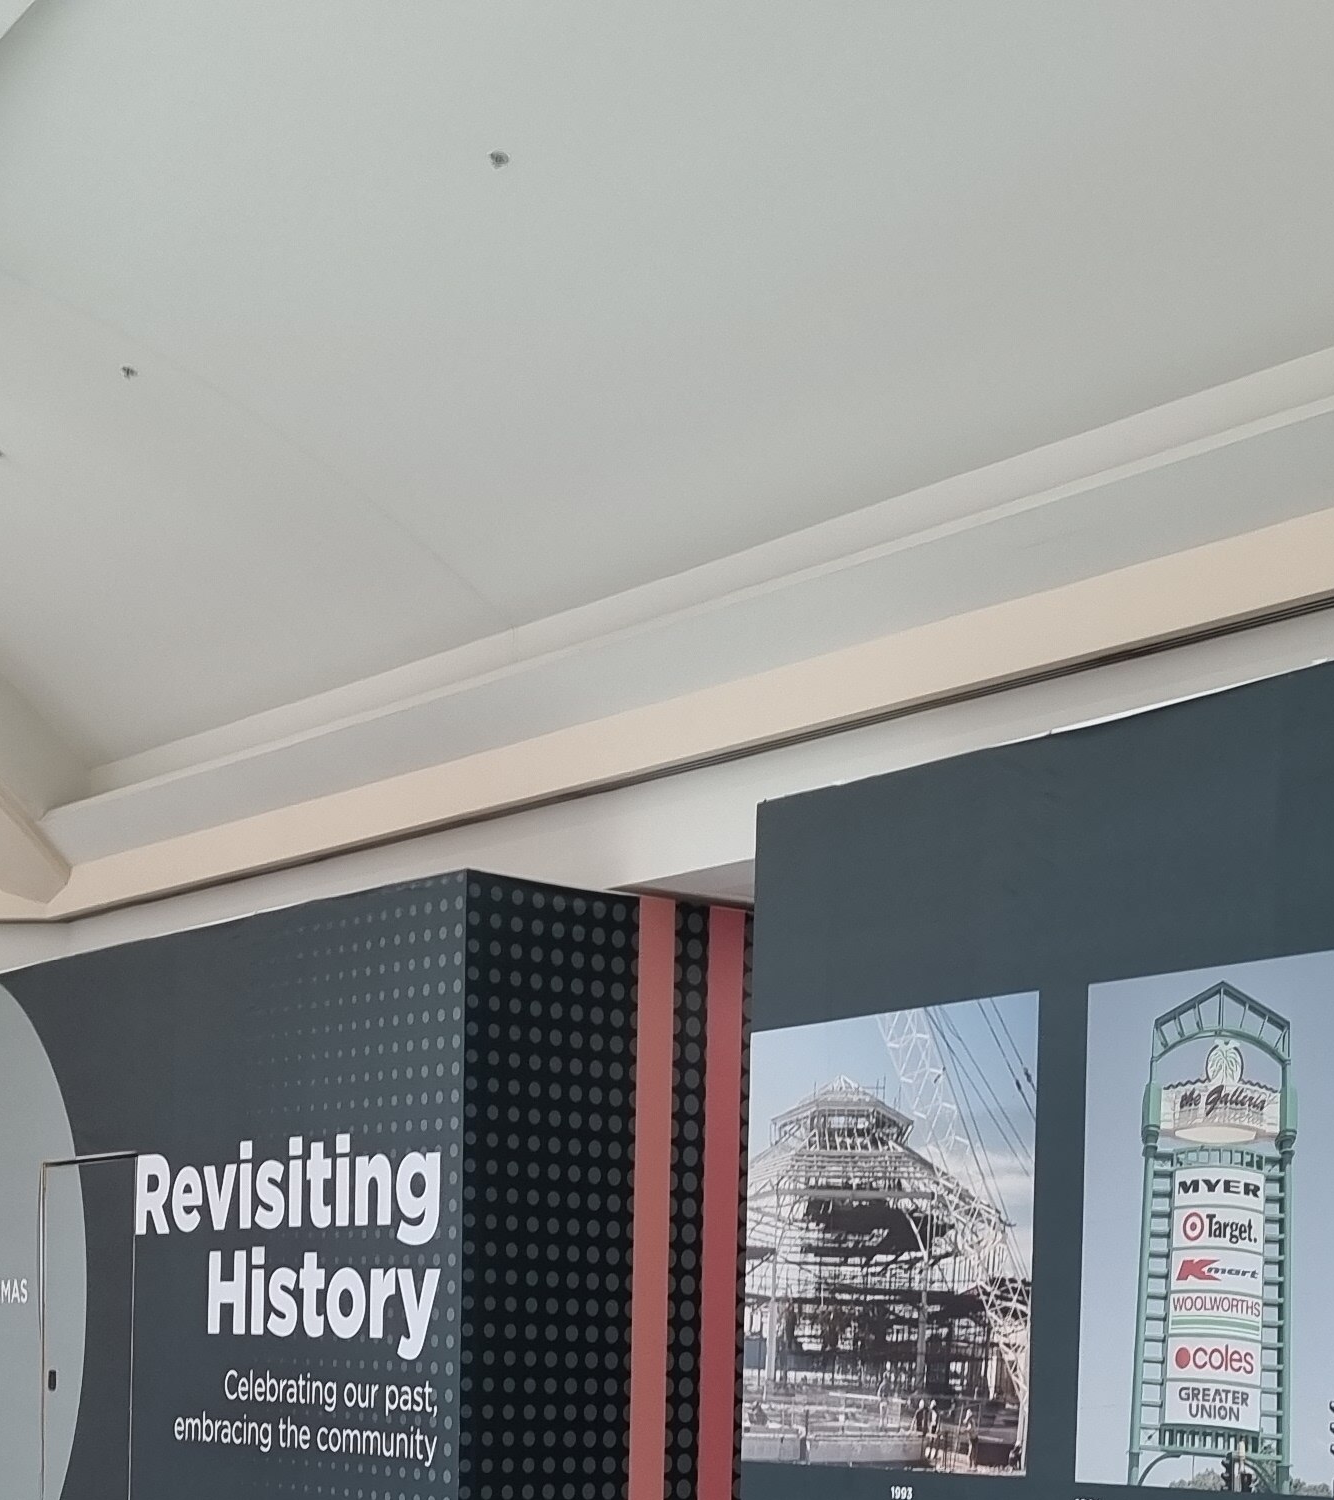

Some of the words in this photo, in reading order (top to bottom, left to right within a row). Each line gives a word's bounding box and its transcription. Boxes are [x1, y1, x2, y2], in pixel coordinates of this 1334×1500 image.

[1179, 1087, 1201, 1110] the
[135, 1133, 441, 1246] Revisiting
[1178, 1178, 1261, 1199] MYER
[1176, 1259, 1260, 1282] Kmart
[207, 1246, 442, 1361] History
[1172, 1296, 1261, 1318] WOOLWORTHS
[1192, 1344, 1255, 1375] coles
[224, 1369, 338, 1411] Celebrating
[343, 1385, 380, 1409] our
[384, 1380, 439, 1417] past,
[1178, 1386, 1250, 1407] GREATER
[1188, 1403, 1240, 1422] UNION
[174, 1411, 272, 1453] embracing
[278, 1416, 312, 1451] the
[316, 1427, 438, 1467] community
[890, 1486, 913, 1500] 1993
